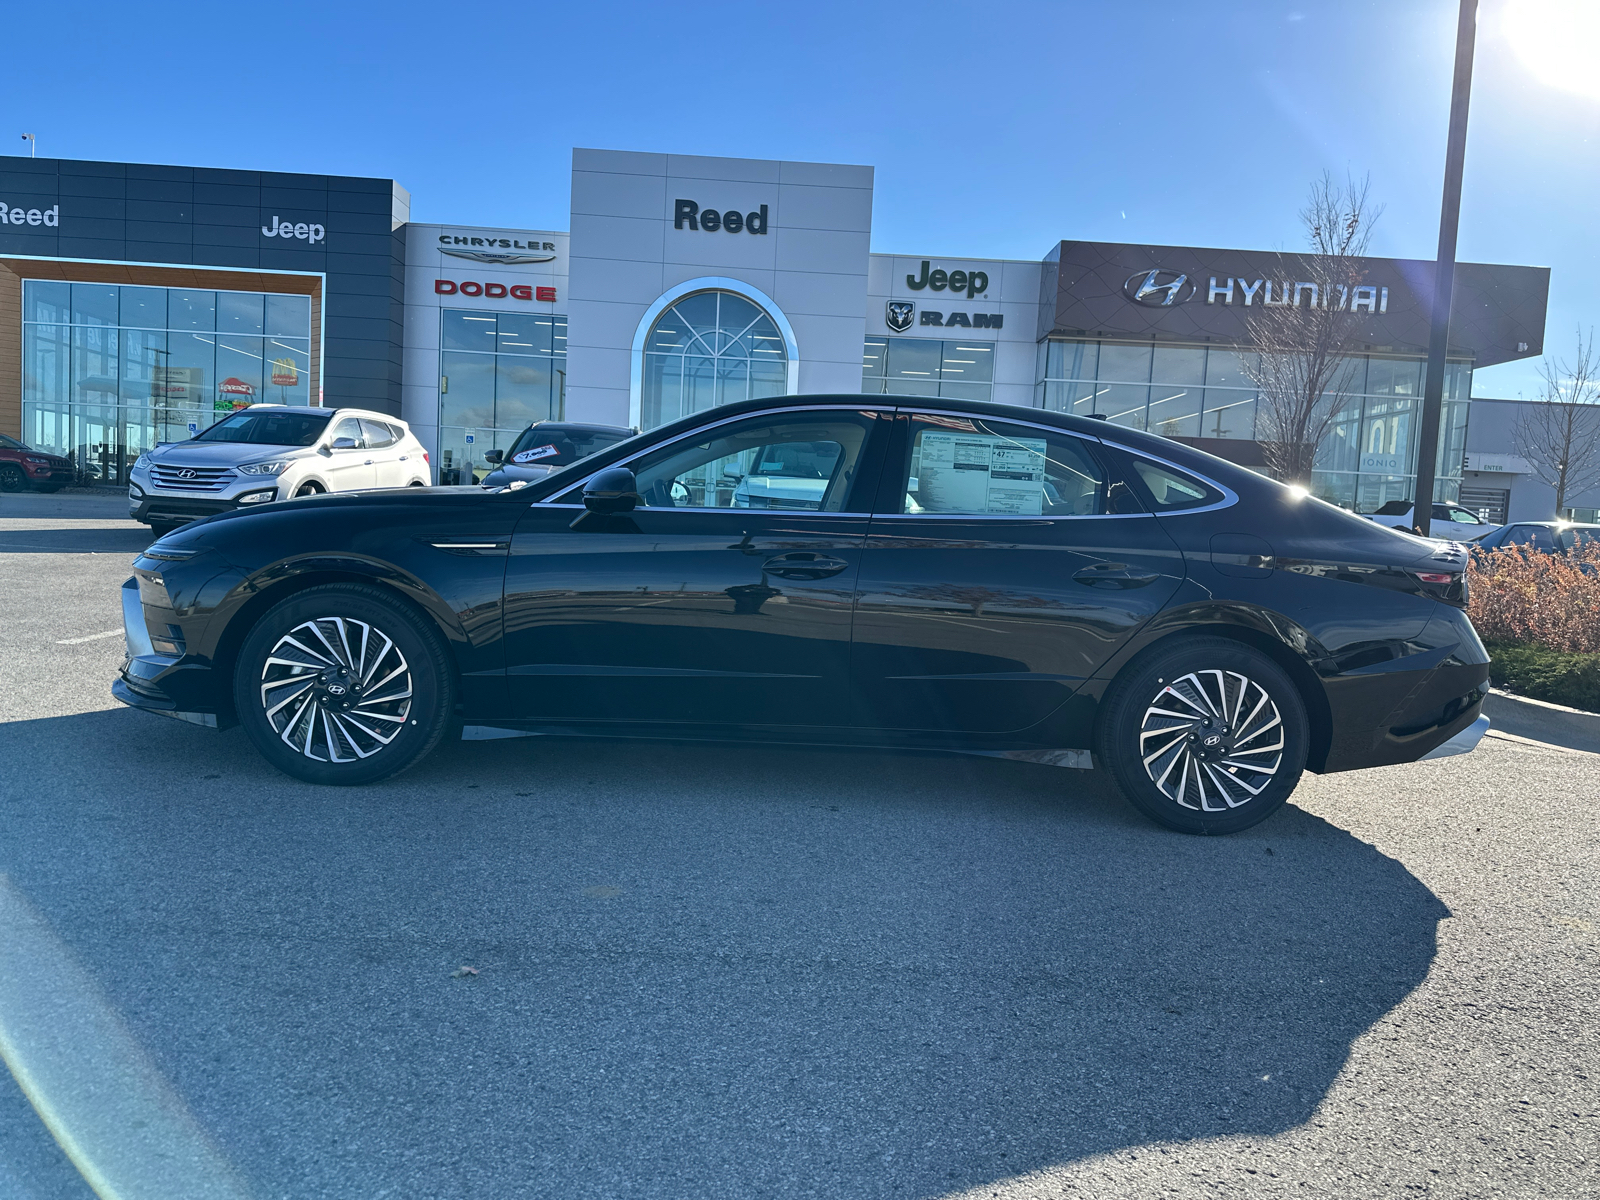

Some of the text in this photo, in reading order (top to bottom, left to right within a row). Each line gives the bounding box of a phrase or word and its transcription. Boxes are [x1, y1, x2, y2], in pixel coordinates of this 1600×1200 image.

[261, 215, 325, 244] Jeep
[674, 198, 769, 235] Reed
[438, 235, 555, 251] CHRYSLER
[434, 279, 557, 302] DODGE
[906, 260, 989, 299] Jeep
[1207, 276, 1389, 314] HYUNDAI
[919, 311, 1004, 329] RAM
[1362, 458, 1397, 468] IONIQ
